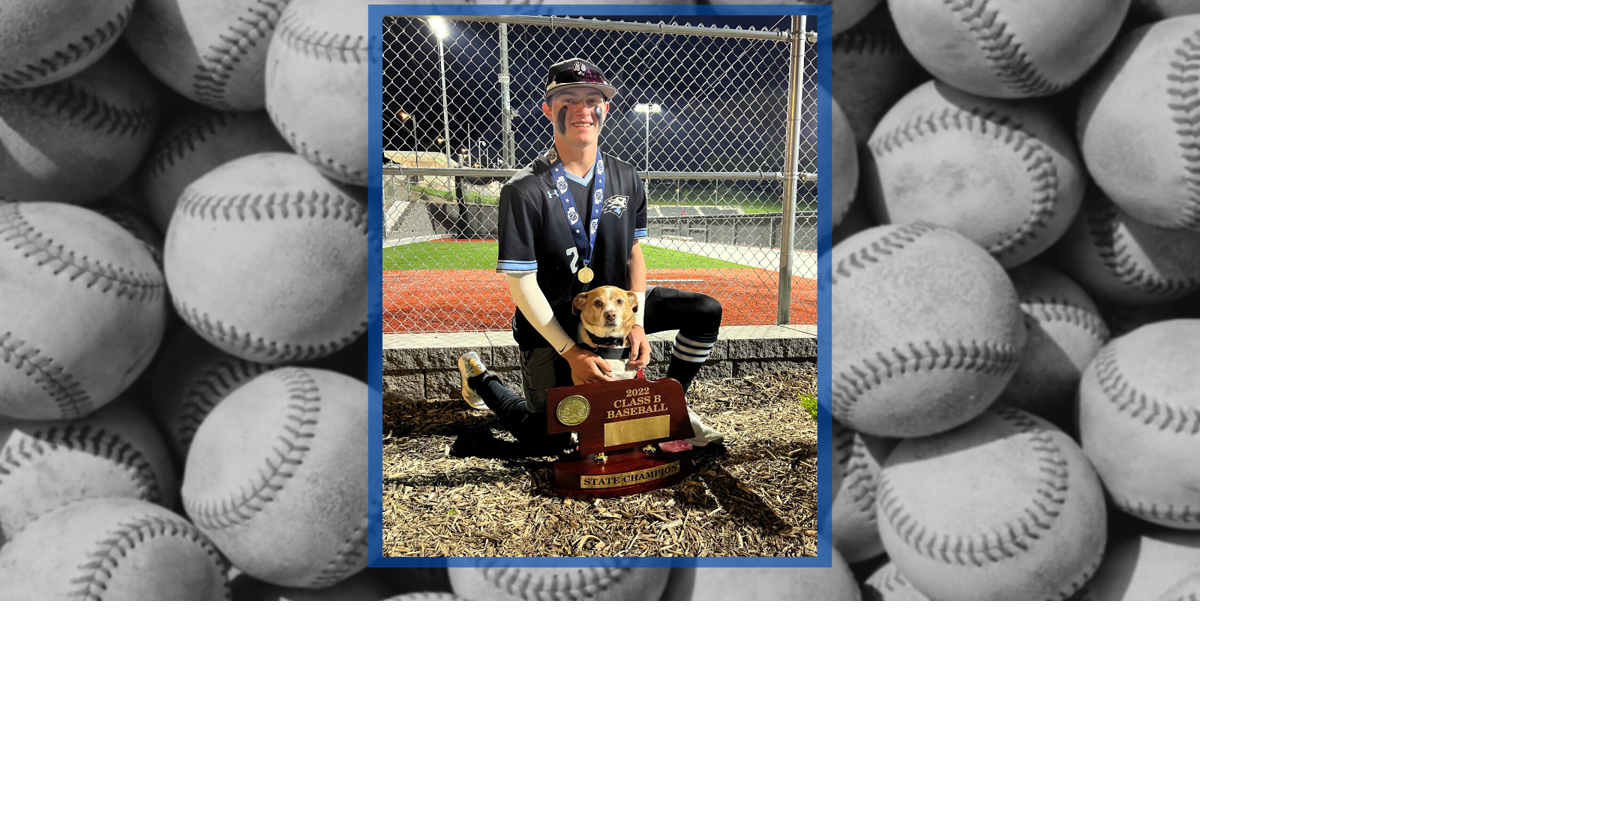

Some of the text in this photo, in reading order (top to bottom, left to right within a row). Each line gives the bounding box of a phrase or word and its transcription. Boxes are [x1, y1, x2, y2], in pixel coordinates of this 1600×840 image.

[625, 386, 650, 398] 2022
[613, 394, 662, 409] CLASS B
[606, 403, 668, 419] BASEBALL
[583, 463, 678, 486] STATE CHAMPION
